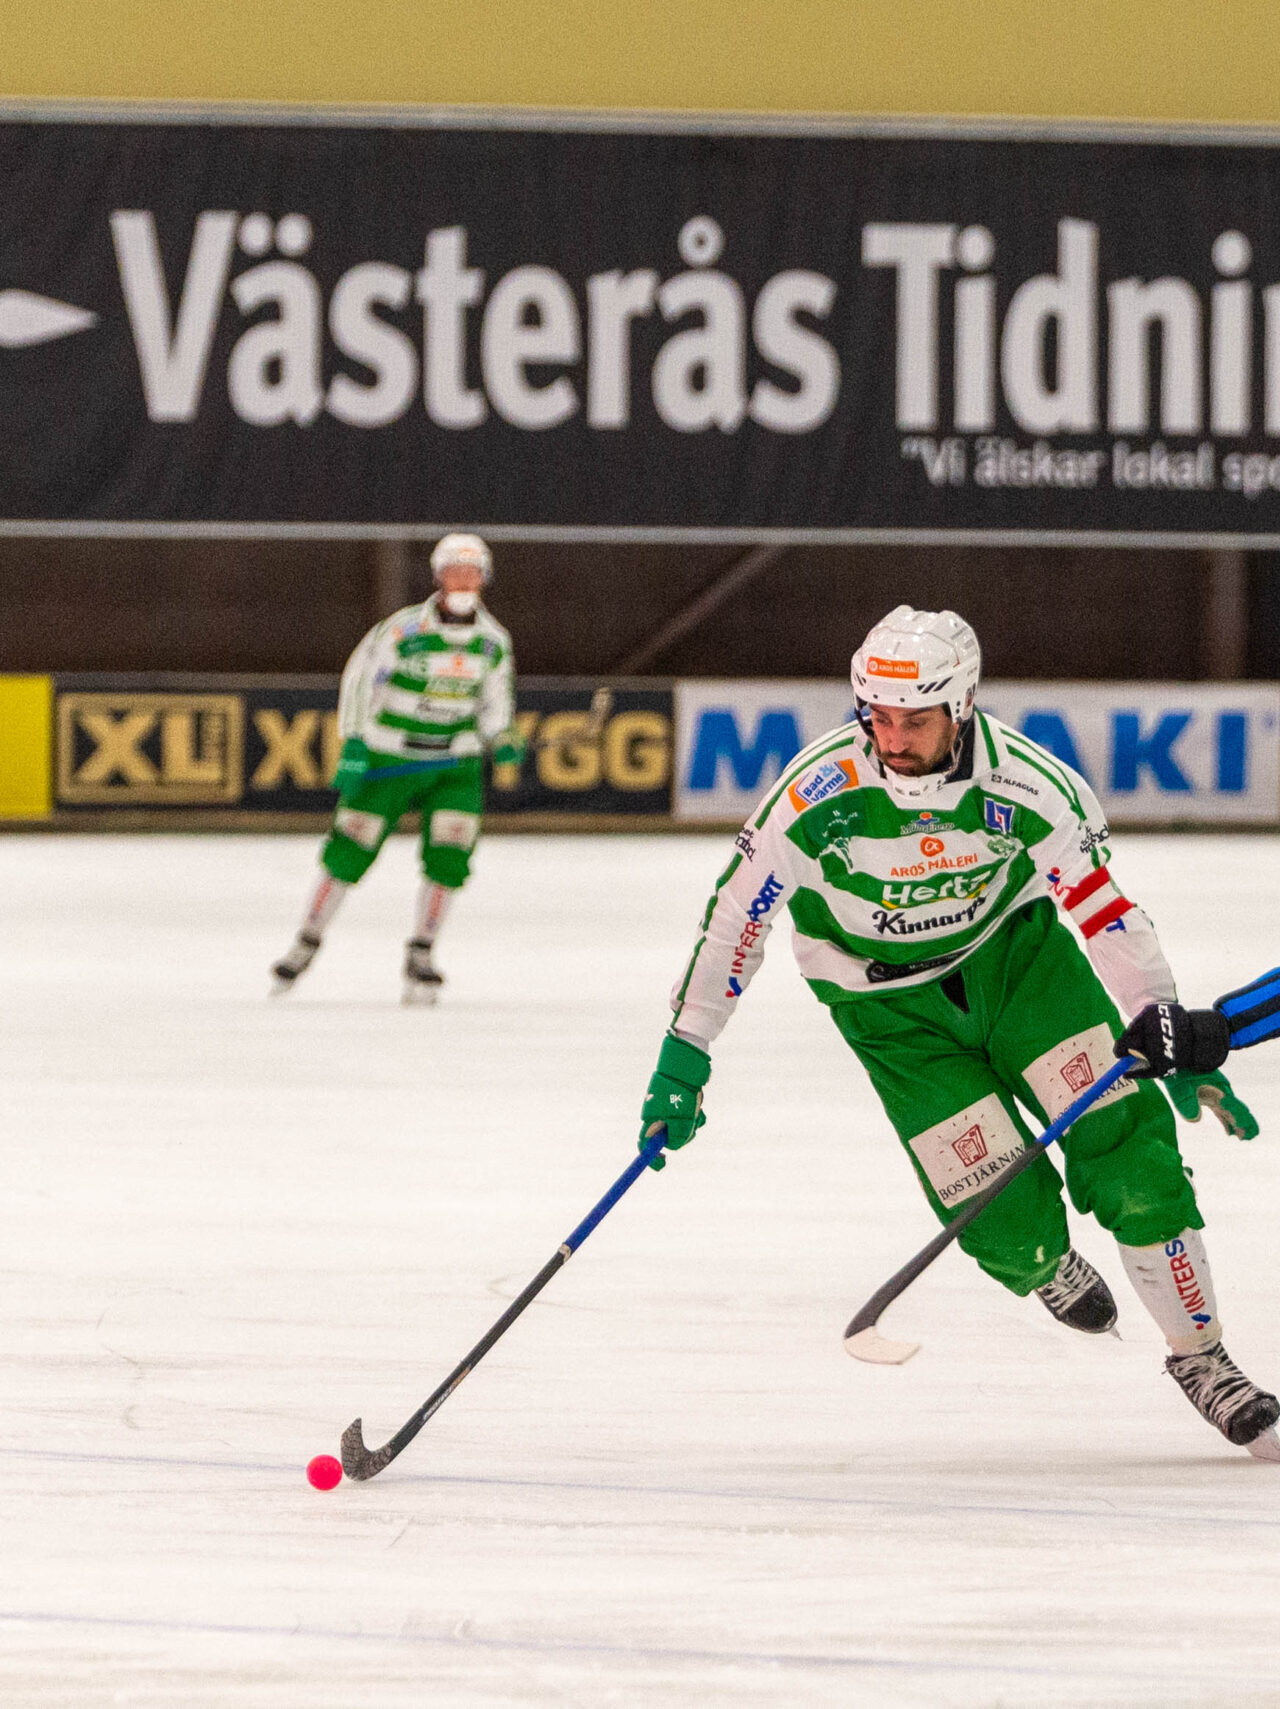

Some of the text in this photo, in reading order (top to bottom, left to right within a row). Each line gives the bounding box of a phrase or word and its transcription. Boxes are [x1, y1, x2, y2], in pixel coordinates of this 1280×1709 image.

[110, 209, 840, 434] Västerås
[974, 435, 1099, 488] älskar
[1111, 440, 1216, 490] lokal
[73, 710, 223, 785] XL
[803, 774, 825, 797] Bad
[811, 773, 845, 802] värme
[882, 869, 992, 904] Hertz
[890, 853, 979, 877] AROS MÅLERI
[871, 896, 988, 936] Kinnarps
[1157, 1004, 1174, 1060] CCM
[938, 1144, 1026, 1201] BOSTJÄRNAN
